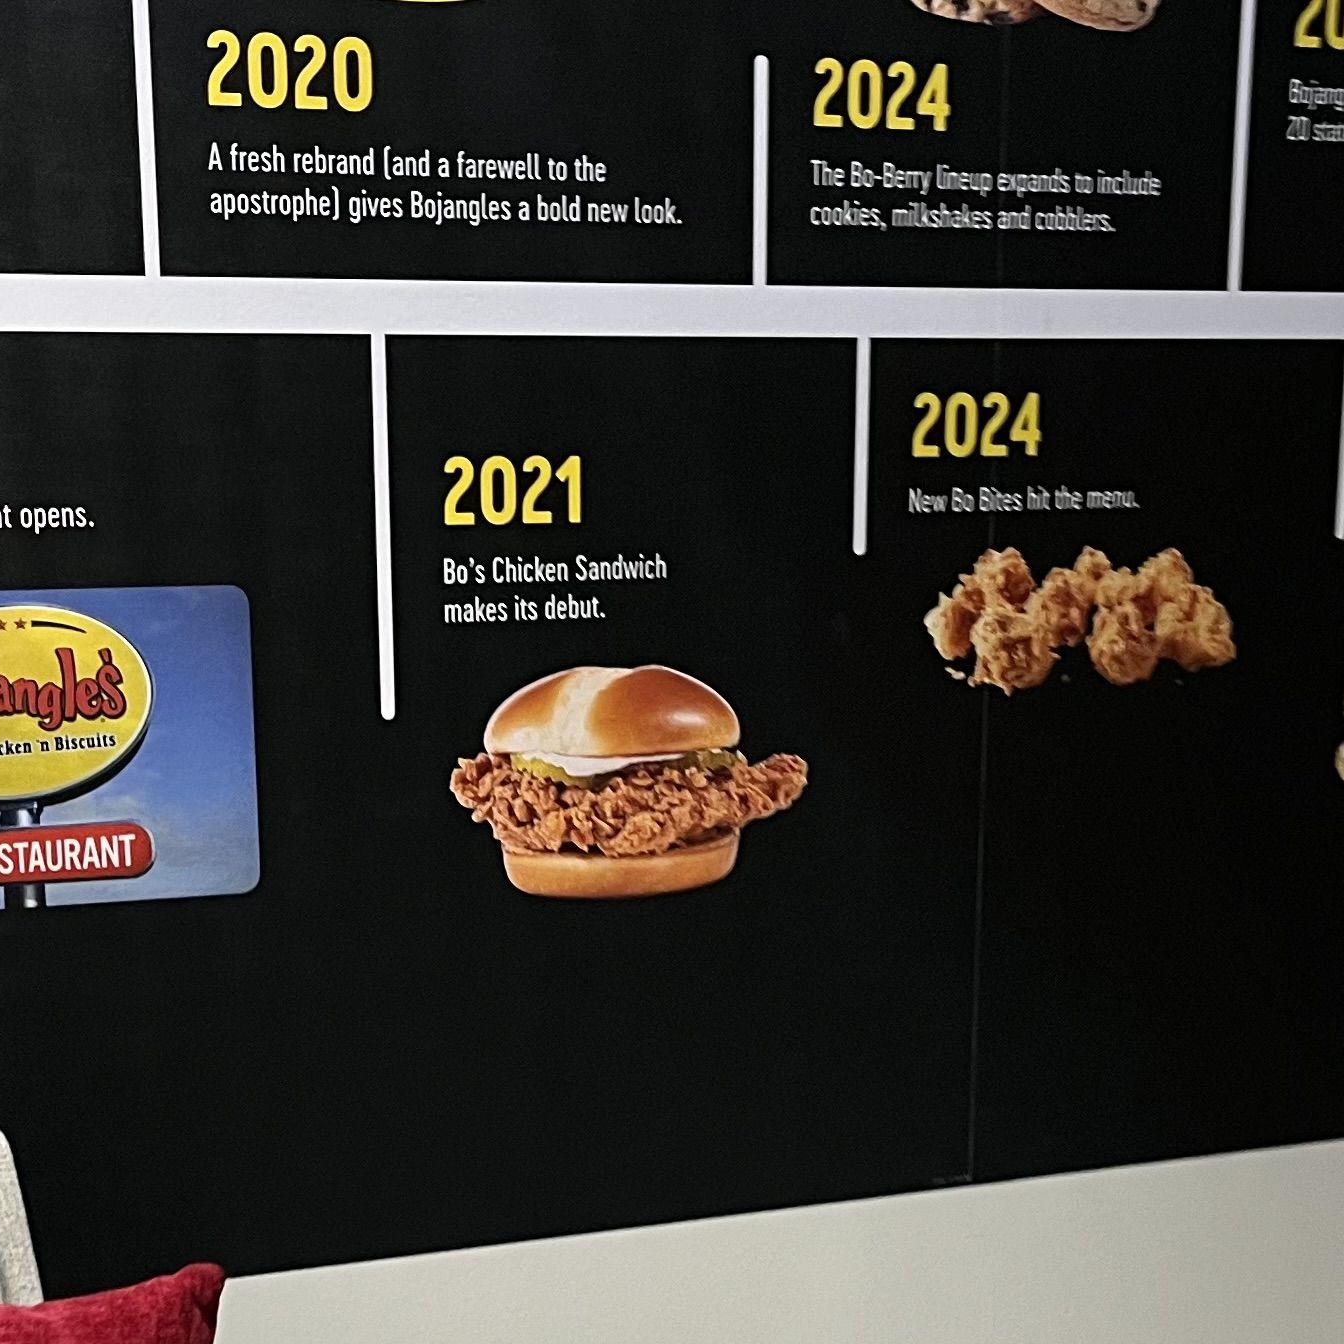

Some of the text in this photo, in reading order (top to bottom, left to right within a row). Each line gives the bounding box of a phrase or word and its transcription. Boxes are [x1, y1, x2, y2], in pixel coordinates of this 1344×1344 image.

[206, 29, 373, 113] 2020
[813, 57, 951, 132] 2024
[207, 141, 607, 183] A fresh rebrand (and a farewell to the
[809, 159, 846, 188] The
[850, 160, 933, 196] Bo-Berry
[935, 163, 994, 198] lineup
[996, 167, 1072, 198] expands
[1096, 168, 1162, 196] include
[210, 185, 683, 227] apostrophe) gives Bojangles a bold new look.
[809, 199, 887, 232] cookies,
[891, 201, 994, 230] milkshakes
[996, 204, 1032, 230] and
[911, 391, 1042, 458] 2024
[443, 454, 582, 526] 2021
[908, 487, 948, 514] New
[19, 506, 95, 535] opens.
[443, 552, 667, 585] Bo's Chicken Sandwich
[444, 593, 606, 624] makes its debut.
[54, 732, 117, 751] Biscuits
